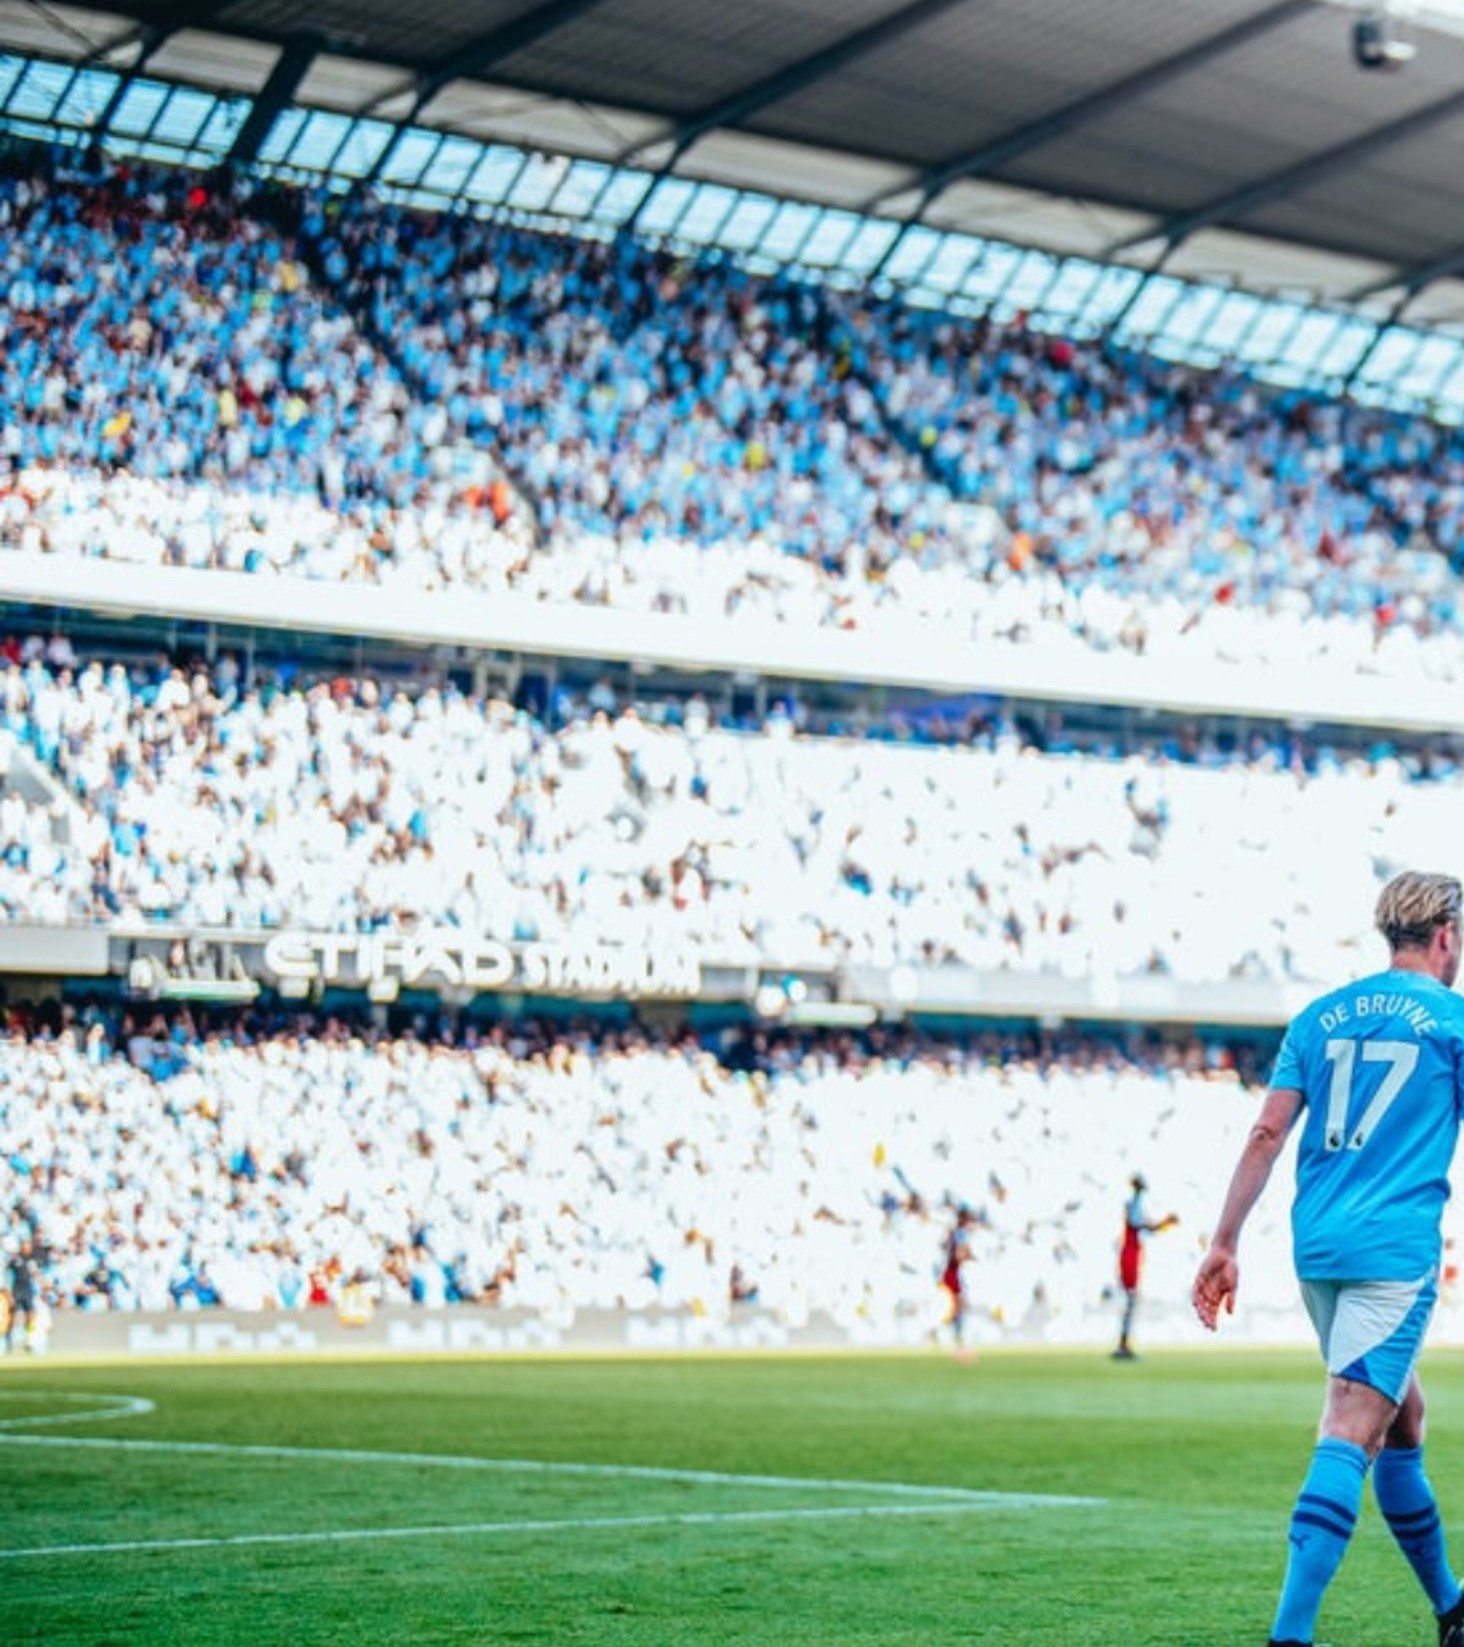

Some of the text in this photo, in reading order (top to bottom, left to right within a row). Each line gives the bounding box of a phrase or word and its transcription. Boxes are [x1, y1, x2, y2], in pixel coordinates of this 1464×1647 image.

[264, 933, 514, 986] ETIHAD
[1319, 994, 1438, 1036] DE BRUYNE
[1325, 1039, 1420, 1151] 17
